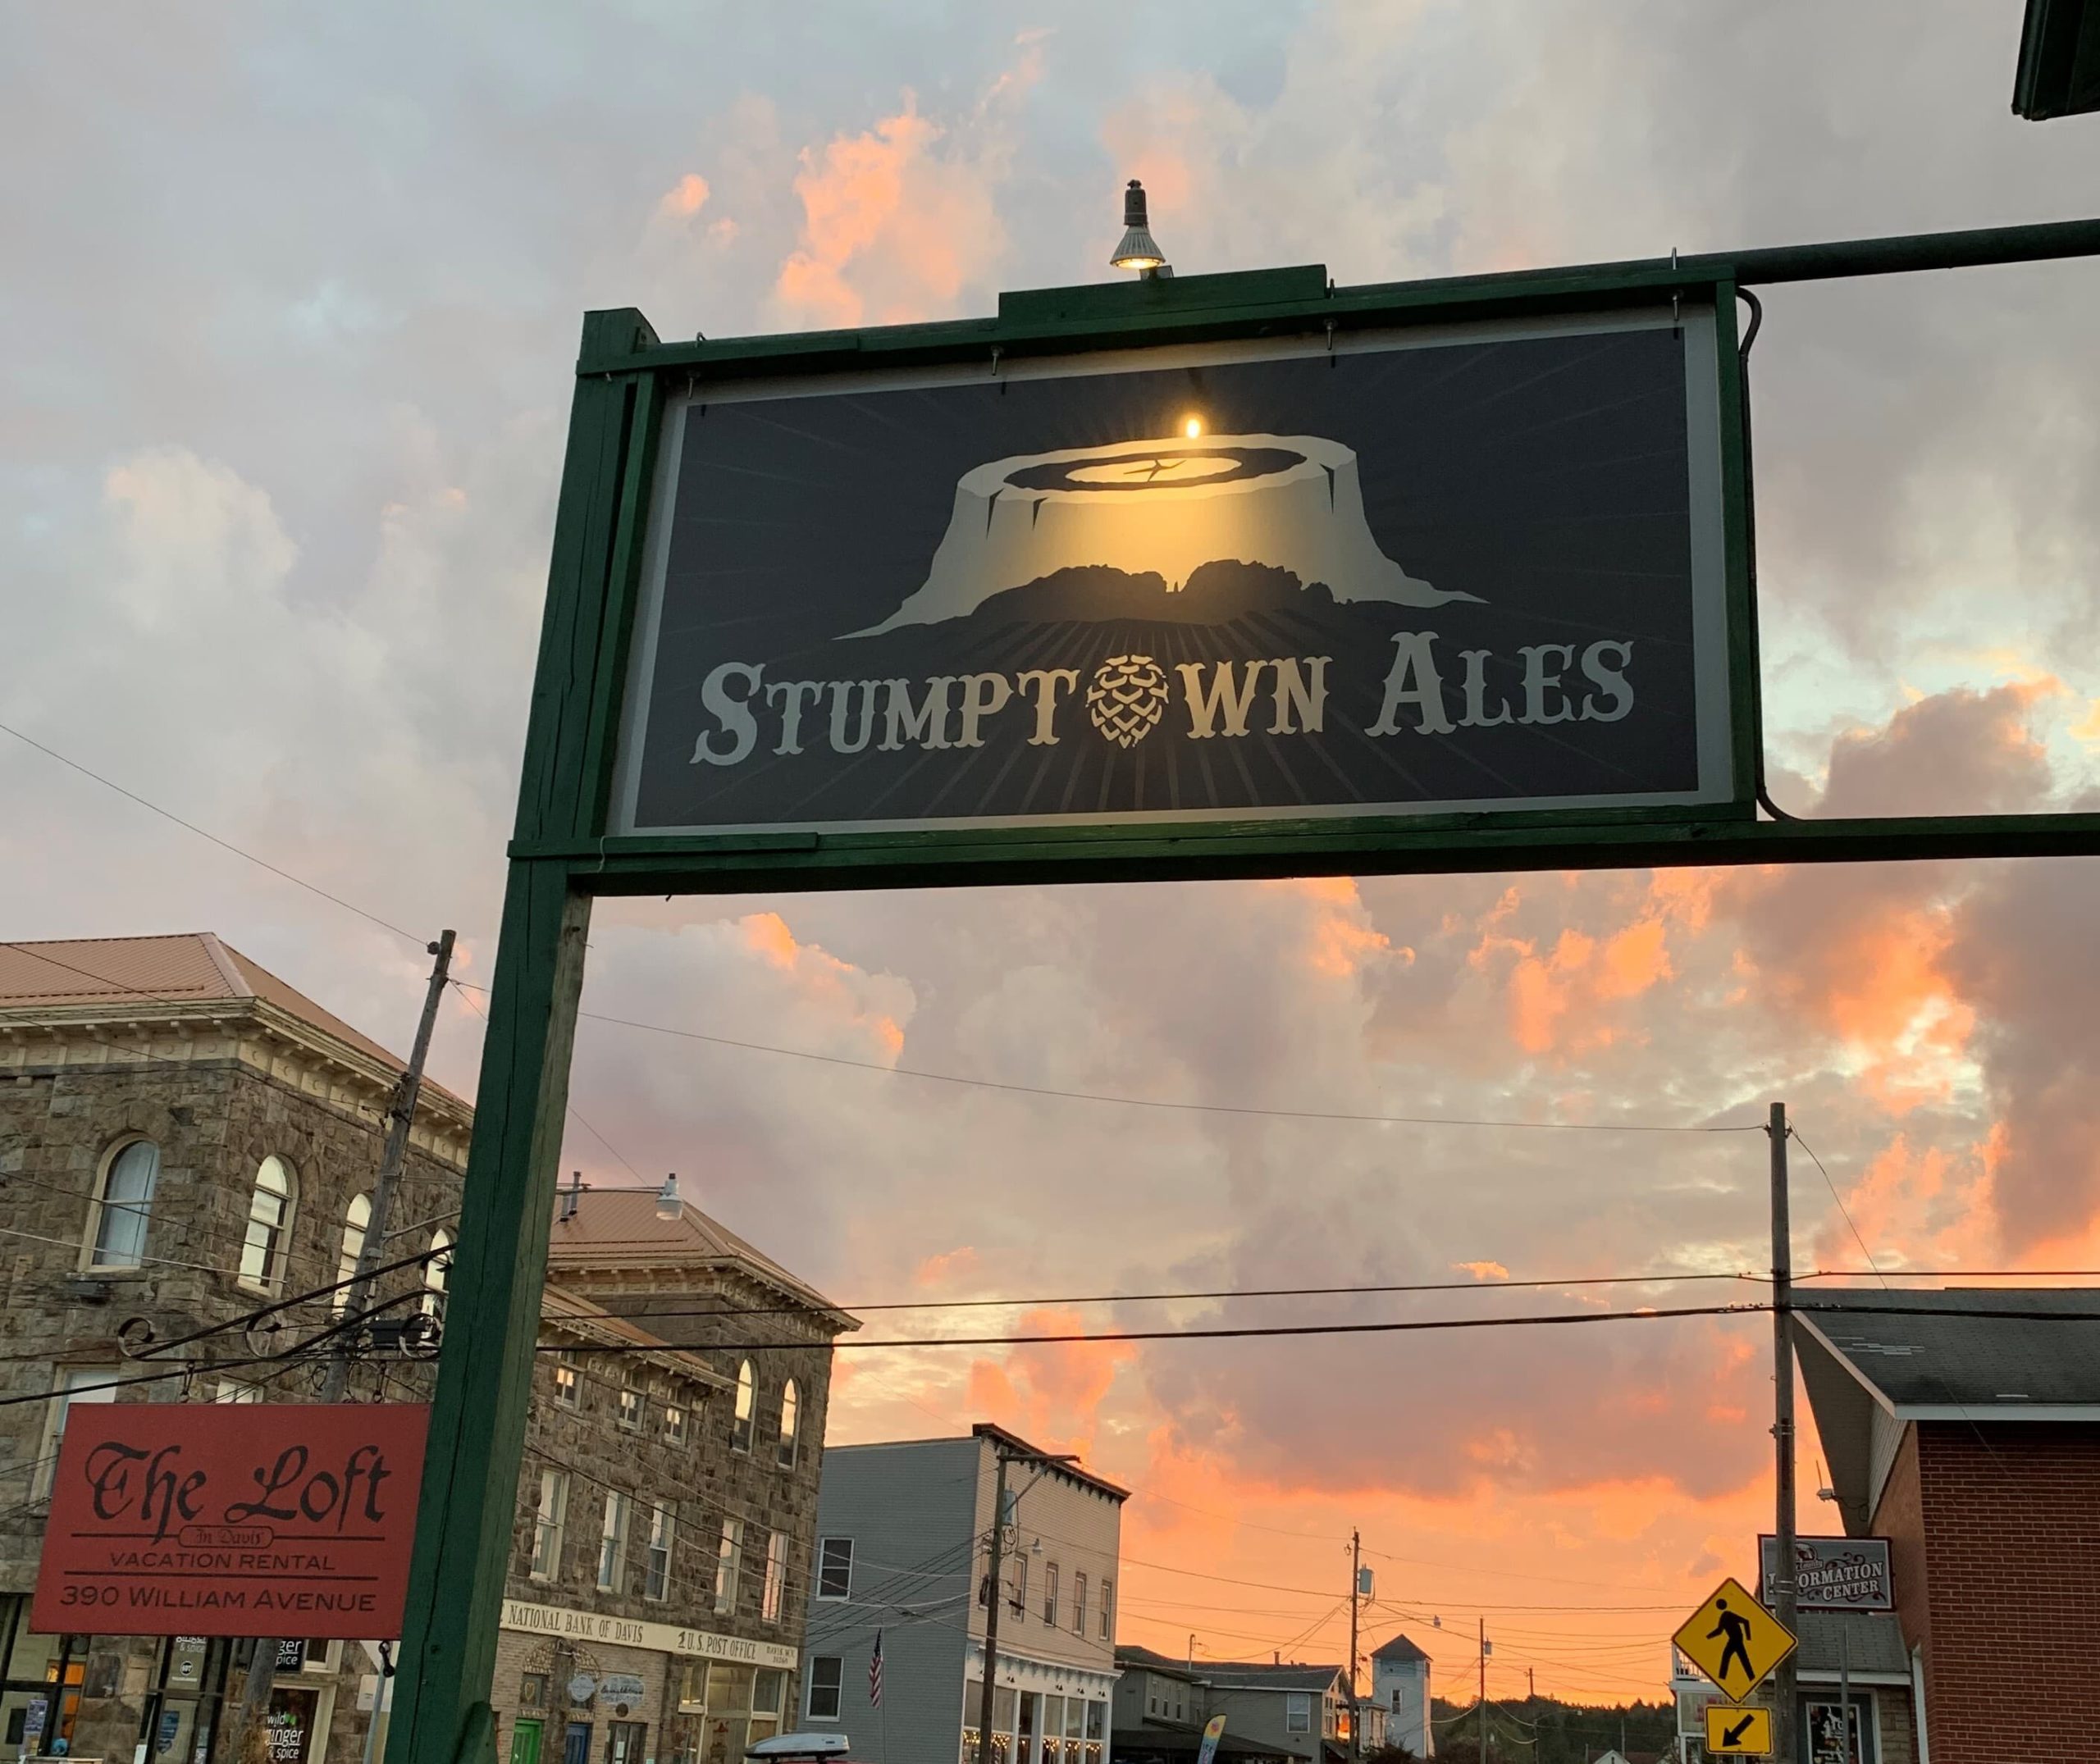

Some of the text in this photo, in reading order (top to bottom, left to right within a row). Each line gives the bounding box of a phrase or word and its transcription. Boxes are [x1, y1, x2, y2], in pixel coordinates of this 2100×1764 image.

[1364, 631, 1634, 736] ALES
[85, 1441, 391, 1546] The Loft
[196, 1528, 212, 1544] In
[110, 1552, 336, 1570] VACATION RENTAL
[60, 1585, 377, 1612] 390 WILLIAM AVENUE
[1822, 1579, 1879, 1601] CENTER
[508, 1604, 644, 1643] NATIONAL BANK OF DAVIS
[705, 1634, 728, 1655] POST
[729, 1639, 757, 1661] OFFICE
[267, 1711, 287, 1725] wild
[276, 1746, 299, 1762] spice
